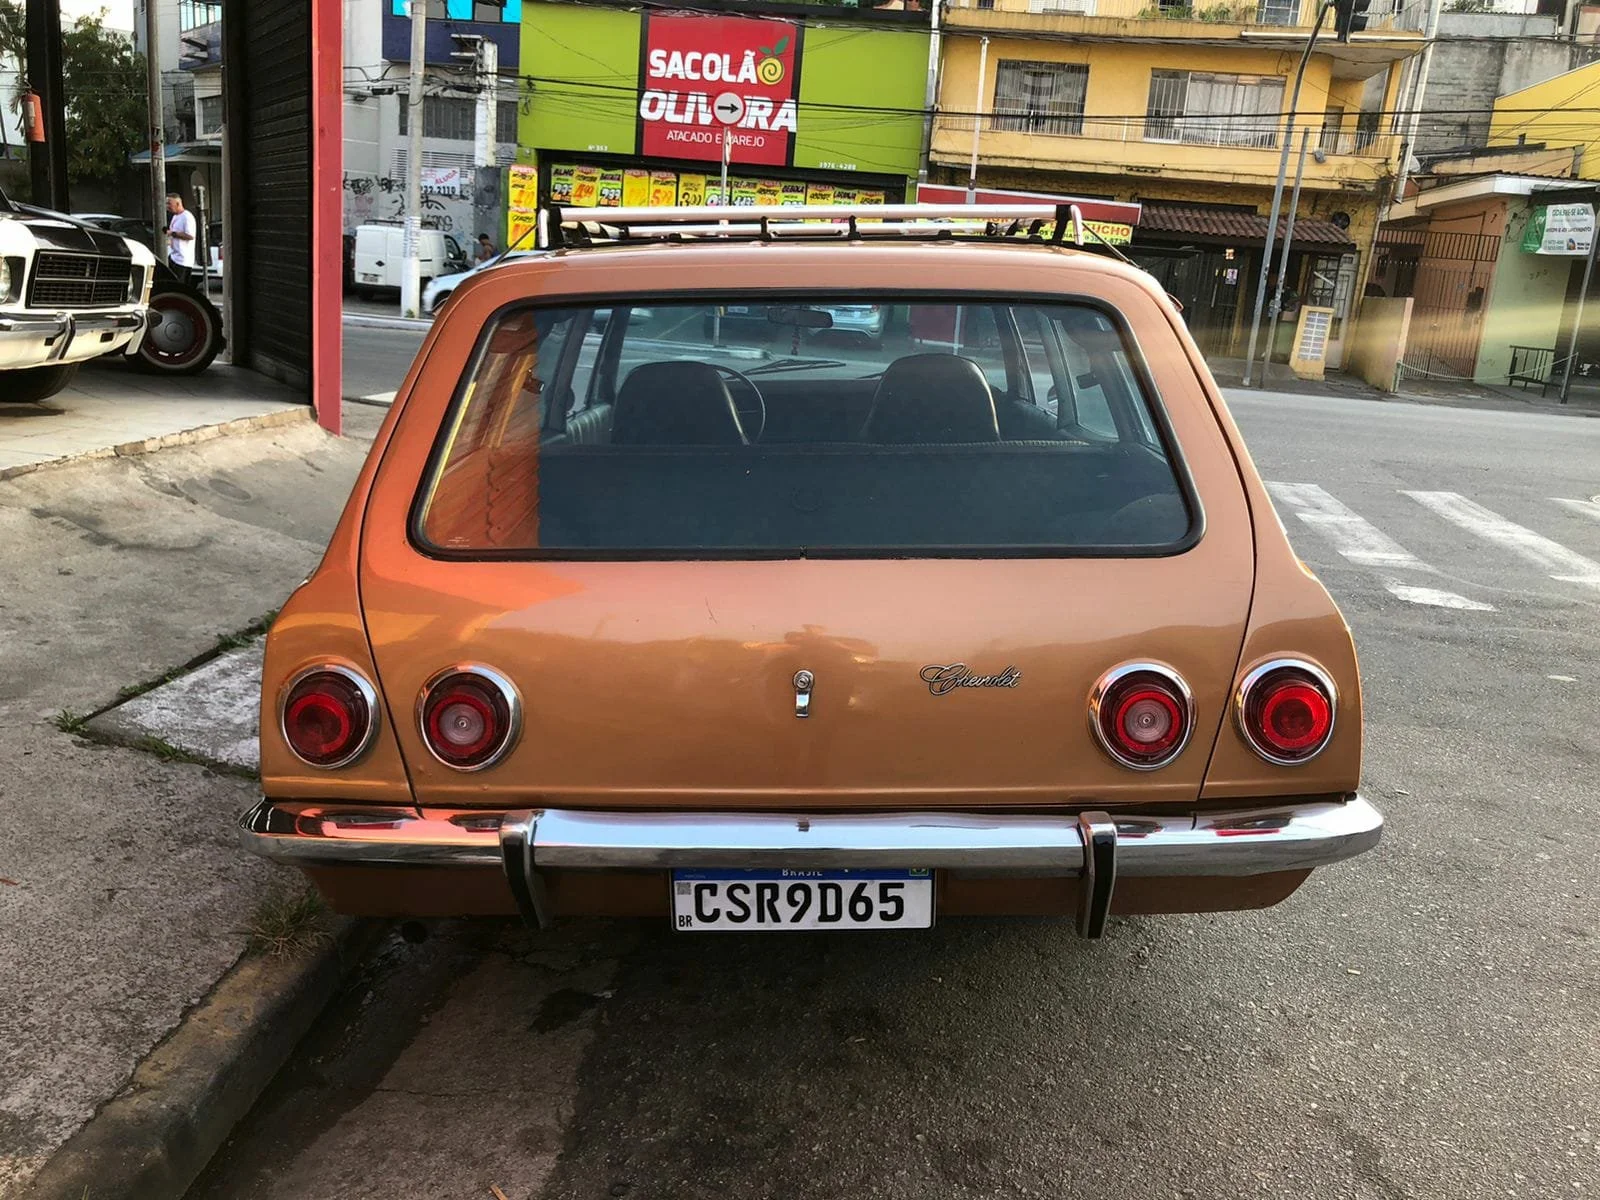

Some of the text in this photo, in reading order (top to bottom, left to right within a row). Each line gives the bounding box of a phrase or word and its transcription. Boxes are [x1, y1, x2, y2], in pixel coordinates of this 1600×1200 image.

[639, 88, 798, 133] OLIVIRA
[666, 129, 712, 144] ATACADO
[715, 133, 722, 144] E
[919, 662, 1022, 696] Chevrolet
[694, 882, 906, 924] CSR9D65
[678, 914, 693, 928] BR
